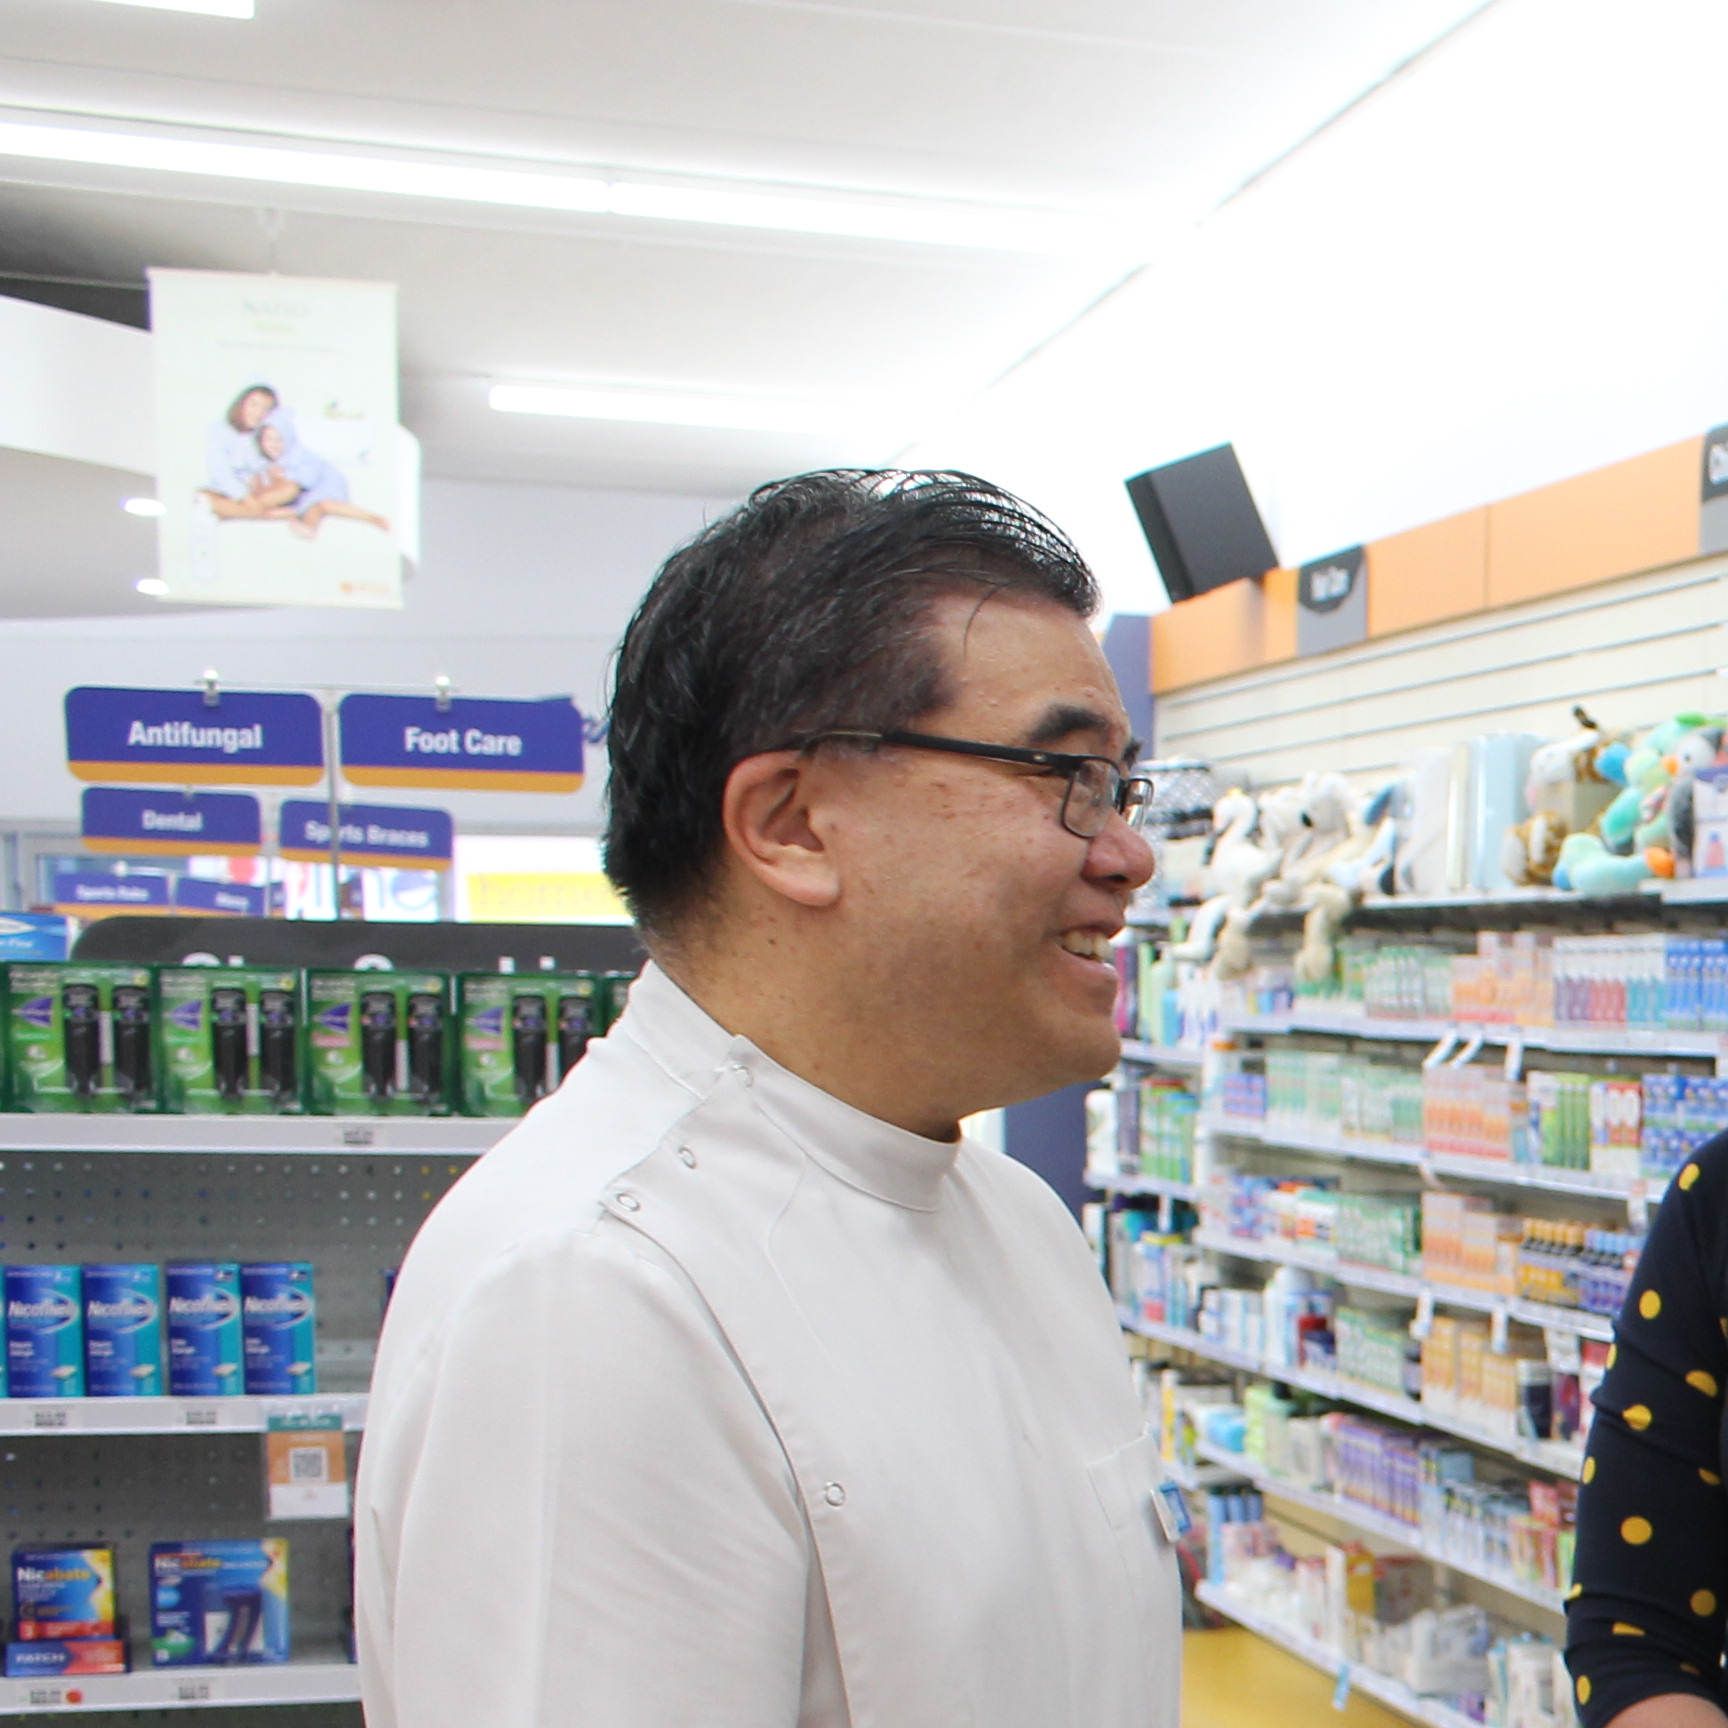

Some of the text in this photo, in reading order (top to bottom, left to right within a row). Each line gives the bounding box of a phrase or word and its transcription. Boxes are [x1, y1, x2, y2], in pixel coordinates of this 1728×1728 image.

[128, 721, 262, 753] Antifungal
[404, 726, 523, 756] Foot Care
[142, 808, 202, 831] Dental
[305, 820, 429, 848] Sprts Braces
[17, 1567, 91, 1582] Nicabate
[154, 1557, 222, 1570] Nicabate
